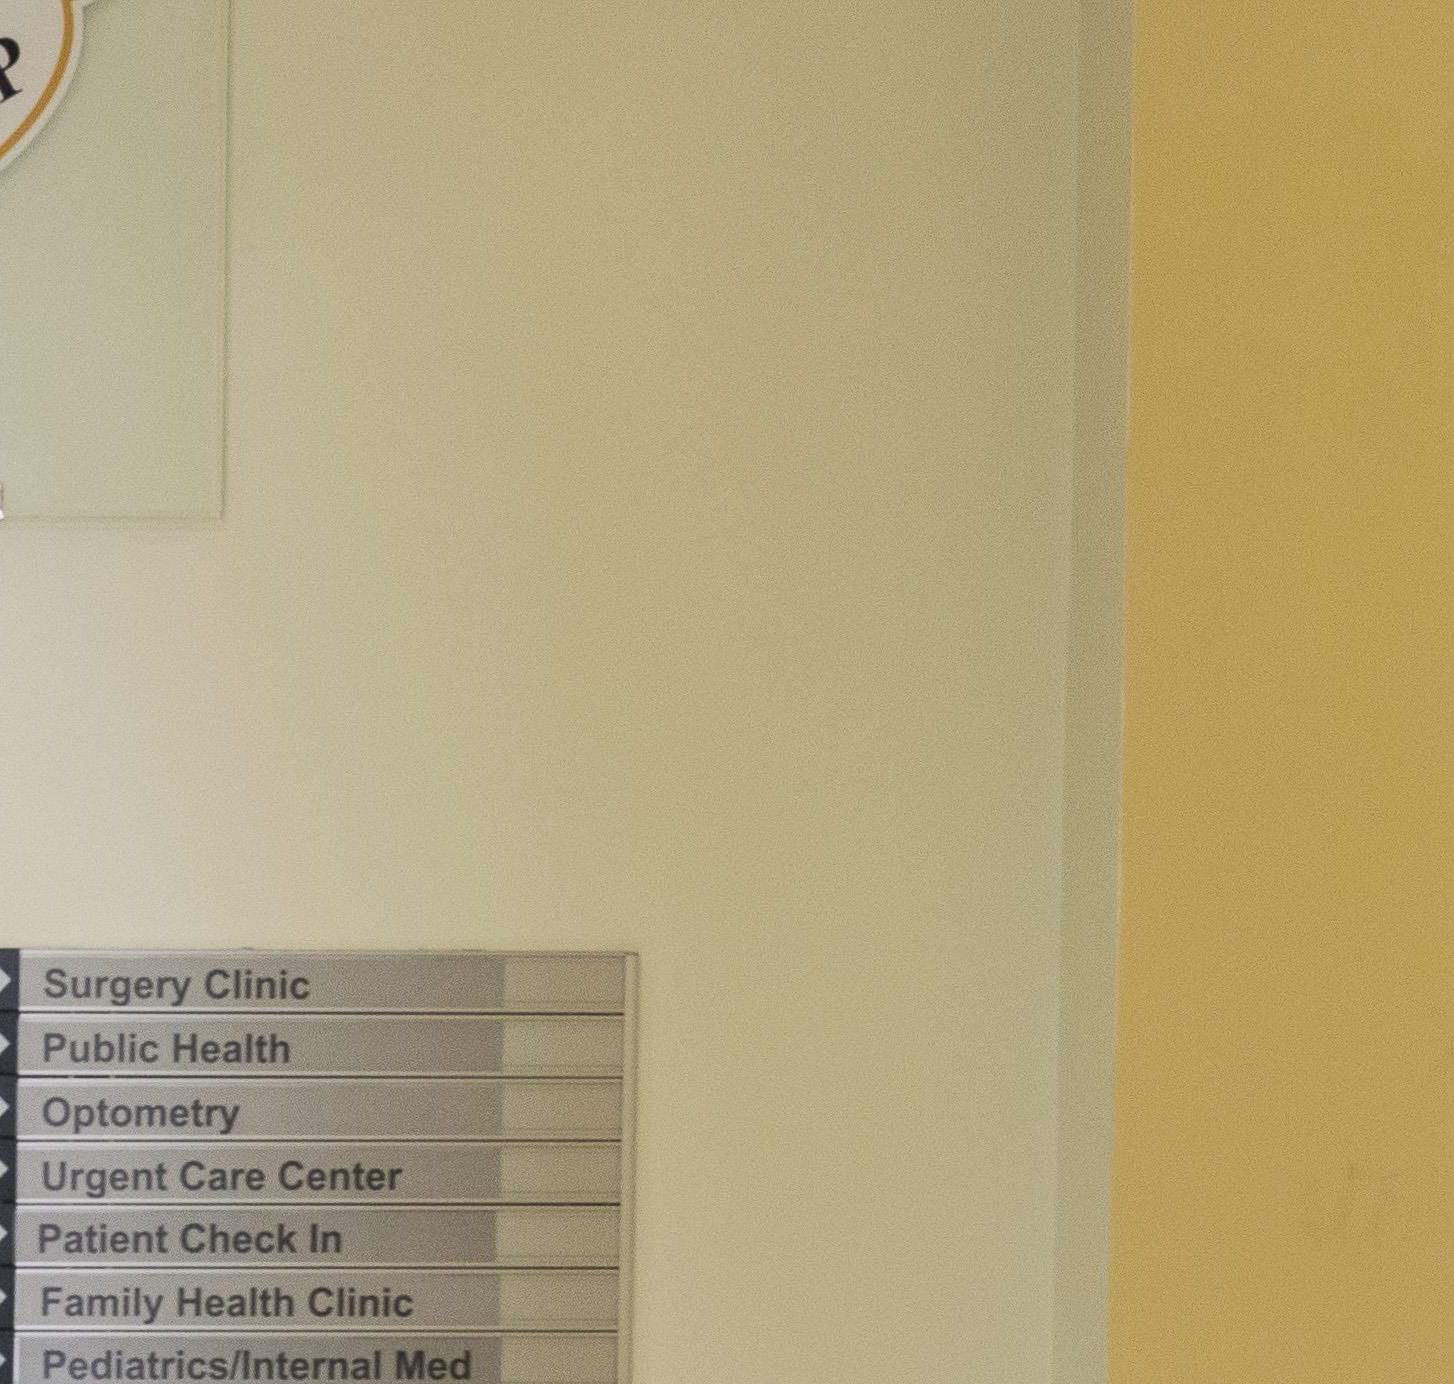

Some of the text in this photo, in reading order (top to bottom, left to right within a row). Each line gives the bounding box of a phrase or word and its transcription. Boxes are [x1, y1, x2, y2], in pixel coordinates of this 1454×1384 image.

[44, 968, 310, 1007] Surgery Clinic
[44, 1032, 291, 1064] Public Health
[43, 1096, 241, 1136] Optometry
[42, 1160, 403, 1199] Urgent Care Center
[39, 1223, 342, 1254] Patient Check In
[42, 1286, 413, 1325] Family Health Clinic
[44, 1349, 472, 1381] Pediatrics/Internal Med
